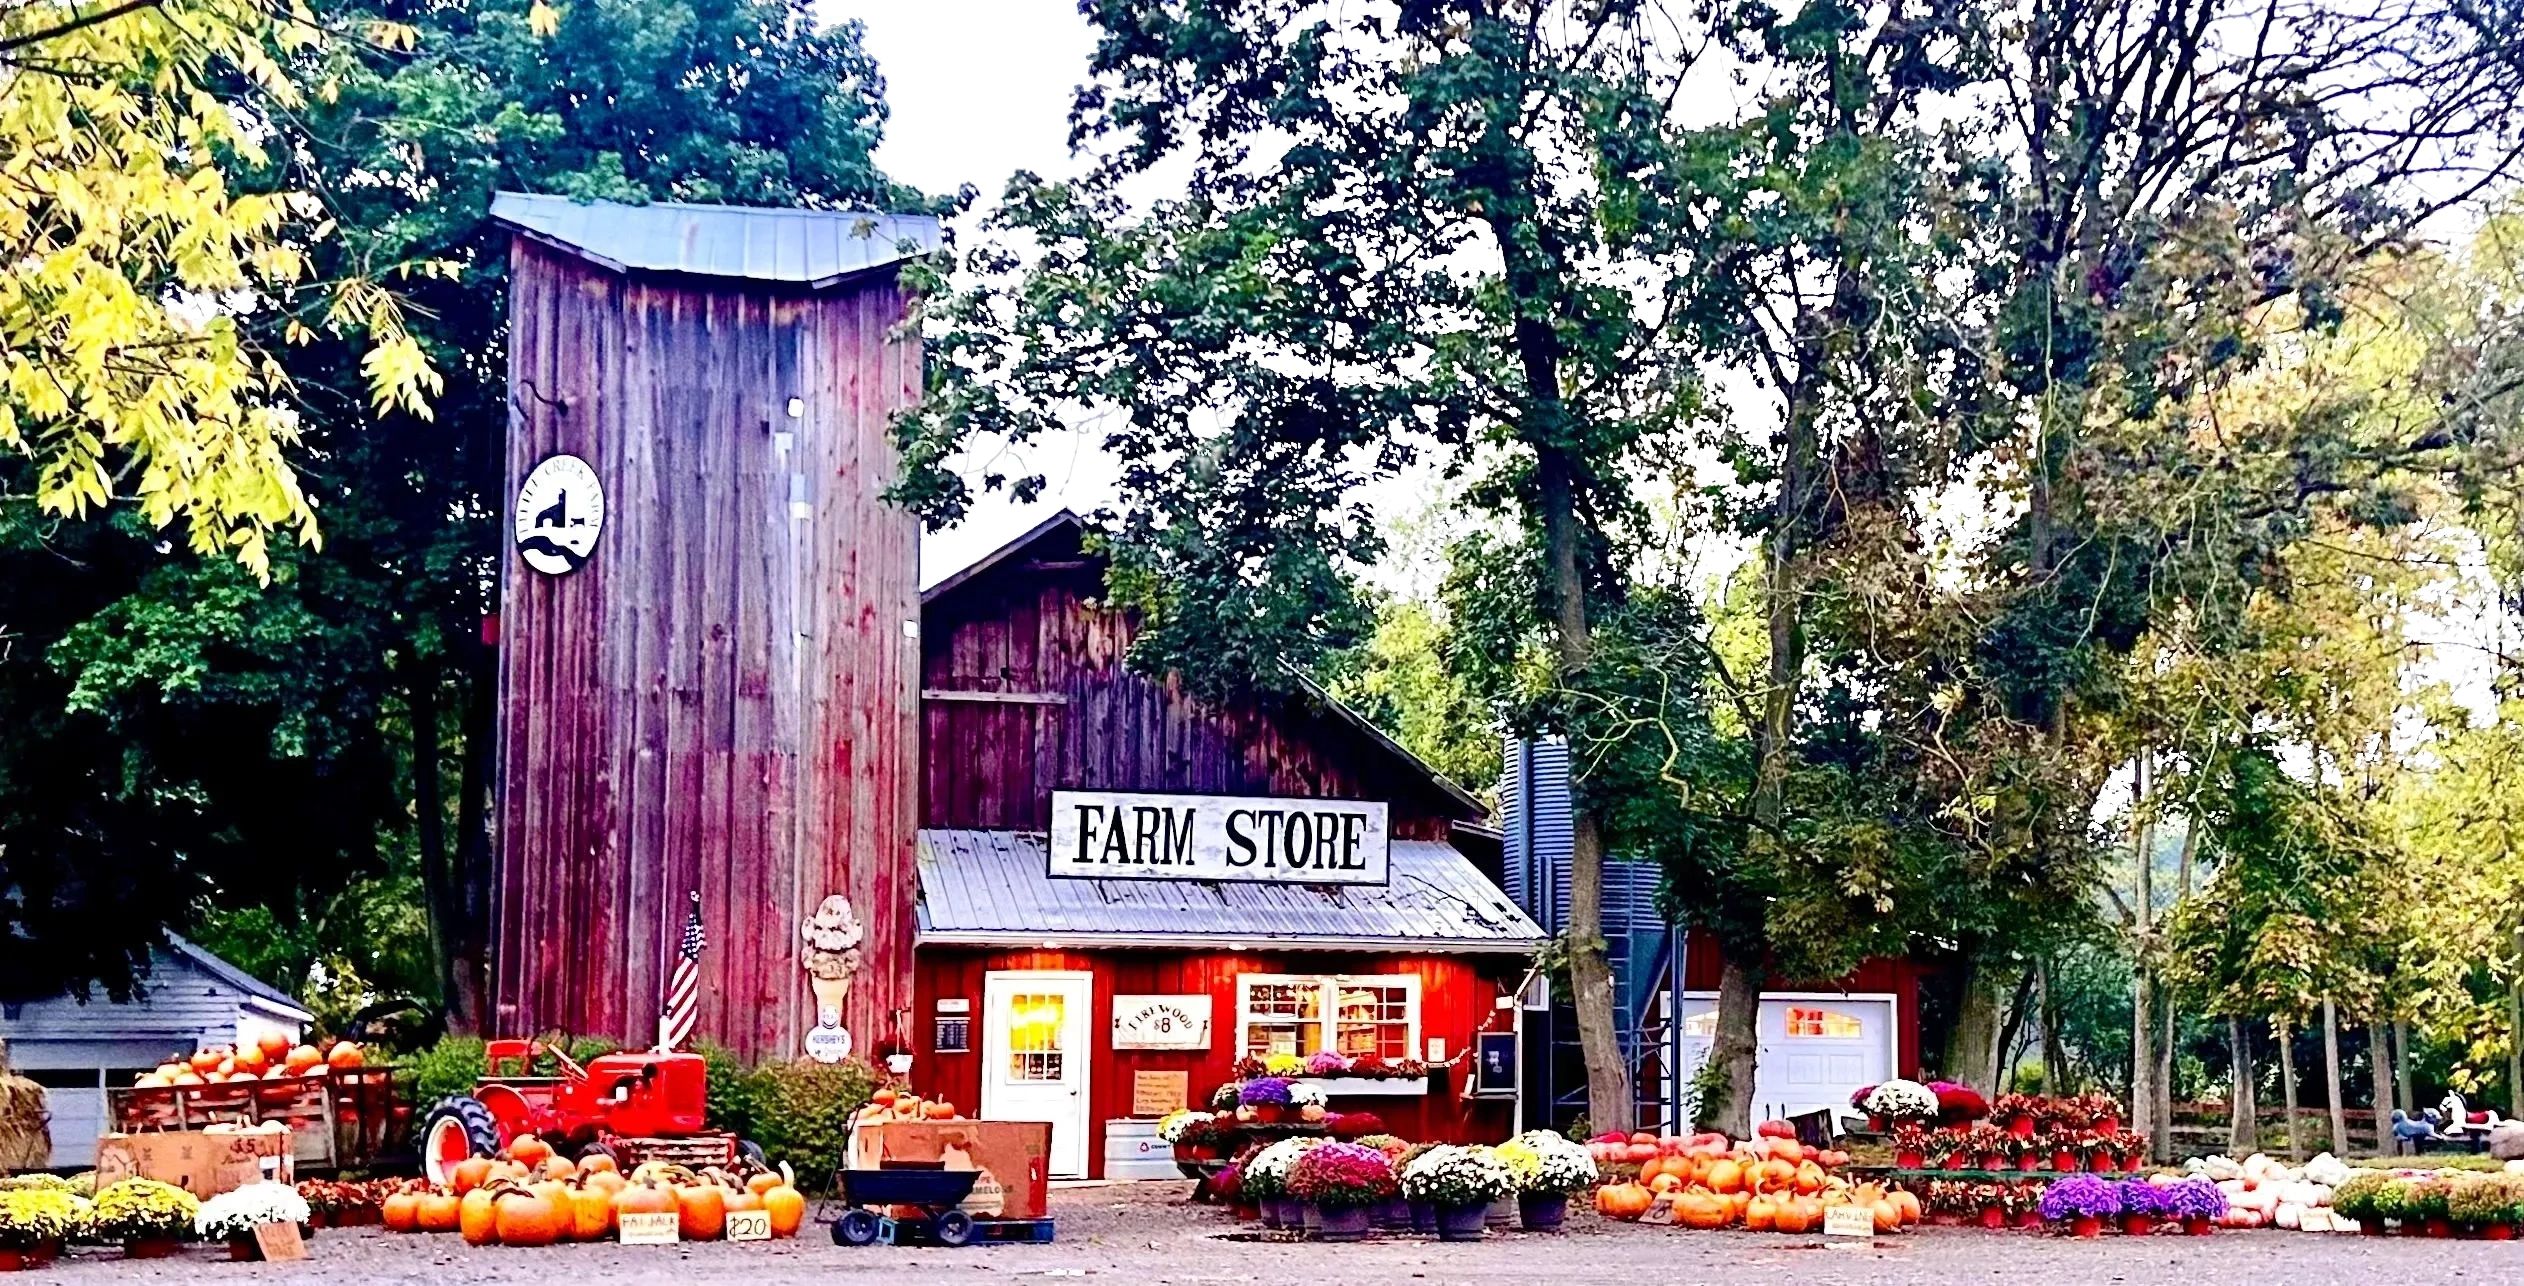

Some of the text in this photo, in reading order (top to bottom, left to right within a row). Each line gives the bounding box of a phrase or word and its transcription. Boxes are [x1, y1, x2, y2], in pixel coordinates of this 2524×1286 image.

[1072, 804, 1368, 870] FARM STORE
[1128, 1004, 1193, 1031] FIREWOOD
[1153, 1017, 1171, 1033] $8
[729, 1216, 767, 1238] $20
